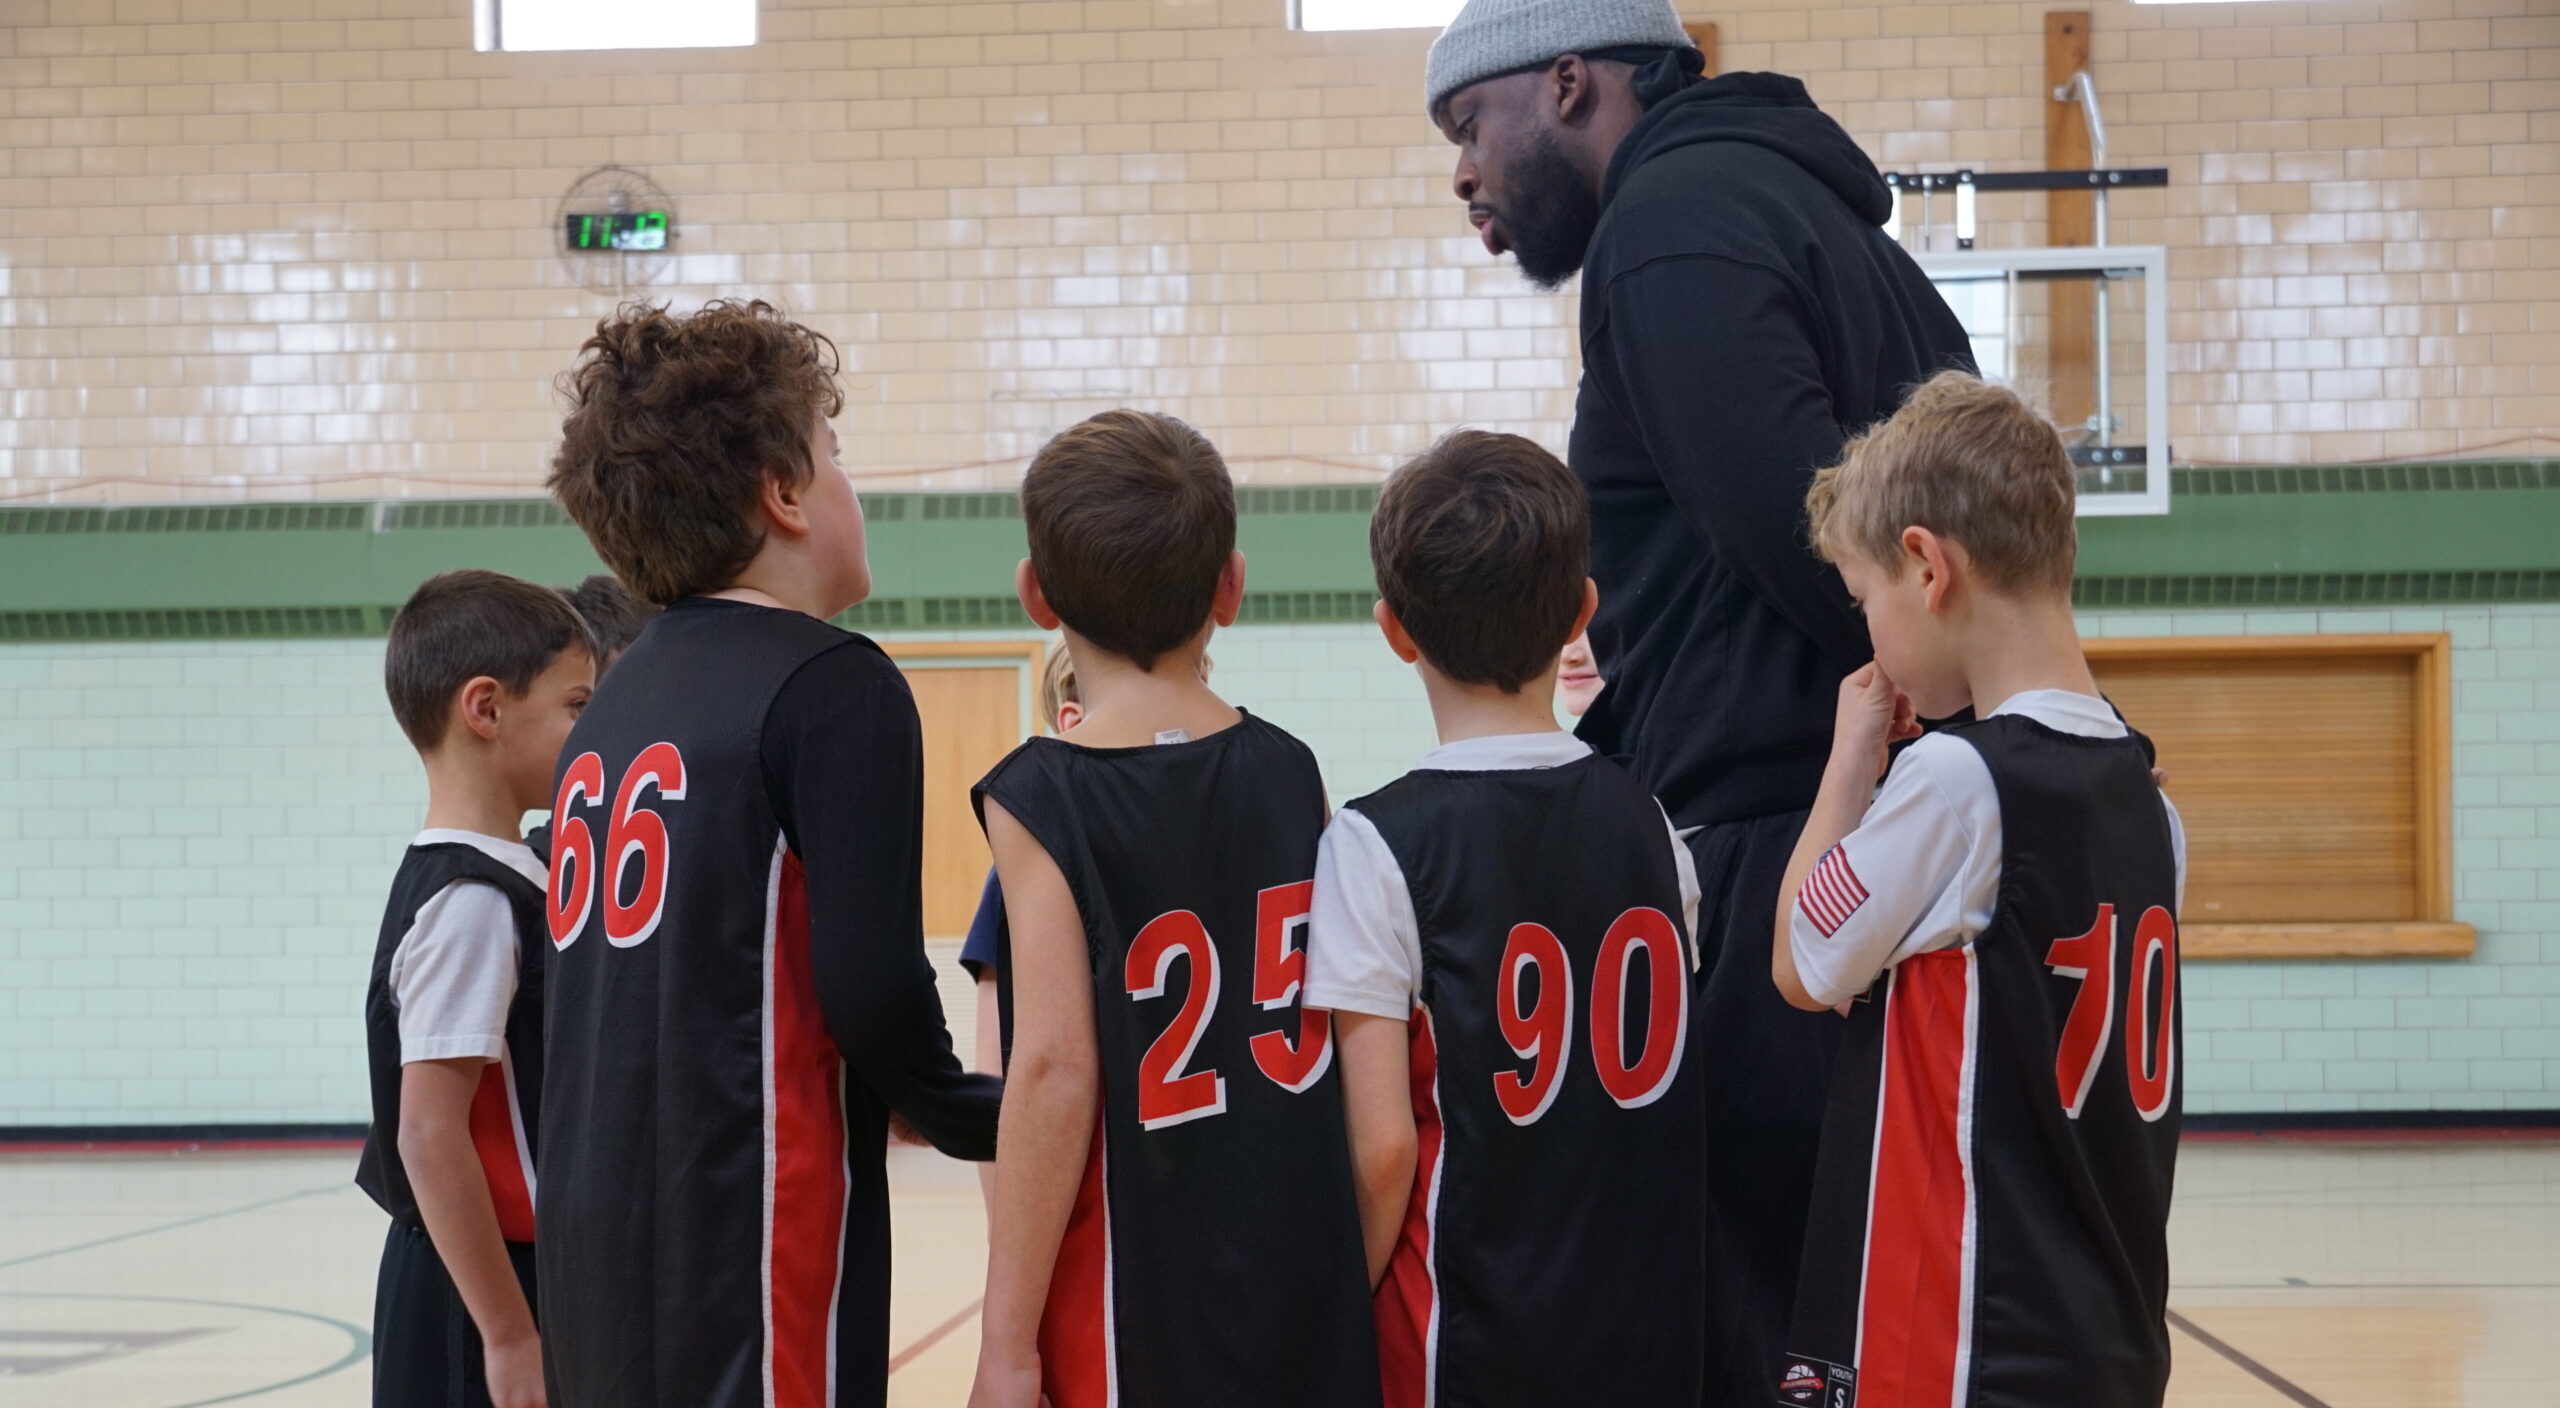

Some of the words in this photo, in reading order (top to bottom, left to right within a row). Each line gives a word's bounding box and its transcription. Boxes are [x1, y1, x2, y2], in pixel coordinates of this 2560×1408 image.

[547, 742, 687, 952] 66
[1125, 879, 1333, 1132] 25
[1494, 907, 1688, 1126] 90
[1831, 1367, 1854, 1381] YOUTH
[1834, 1388, 1846, 1408] S
